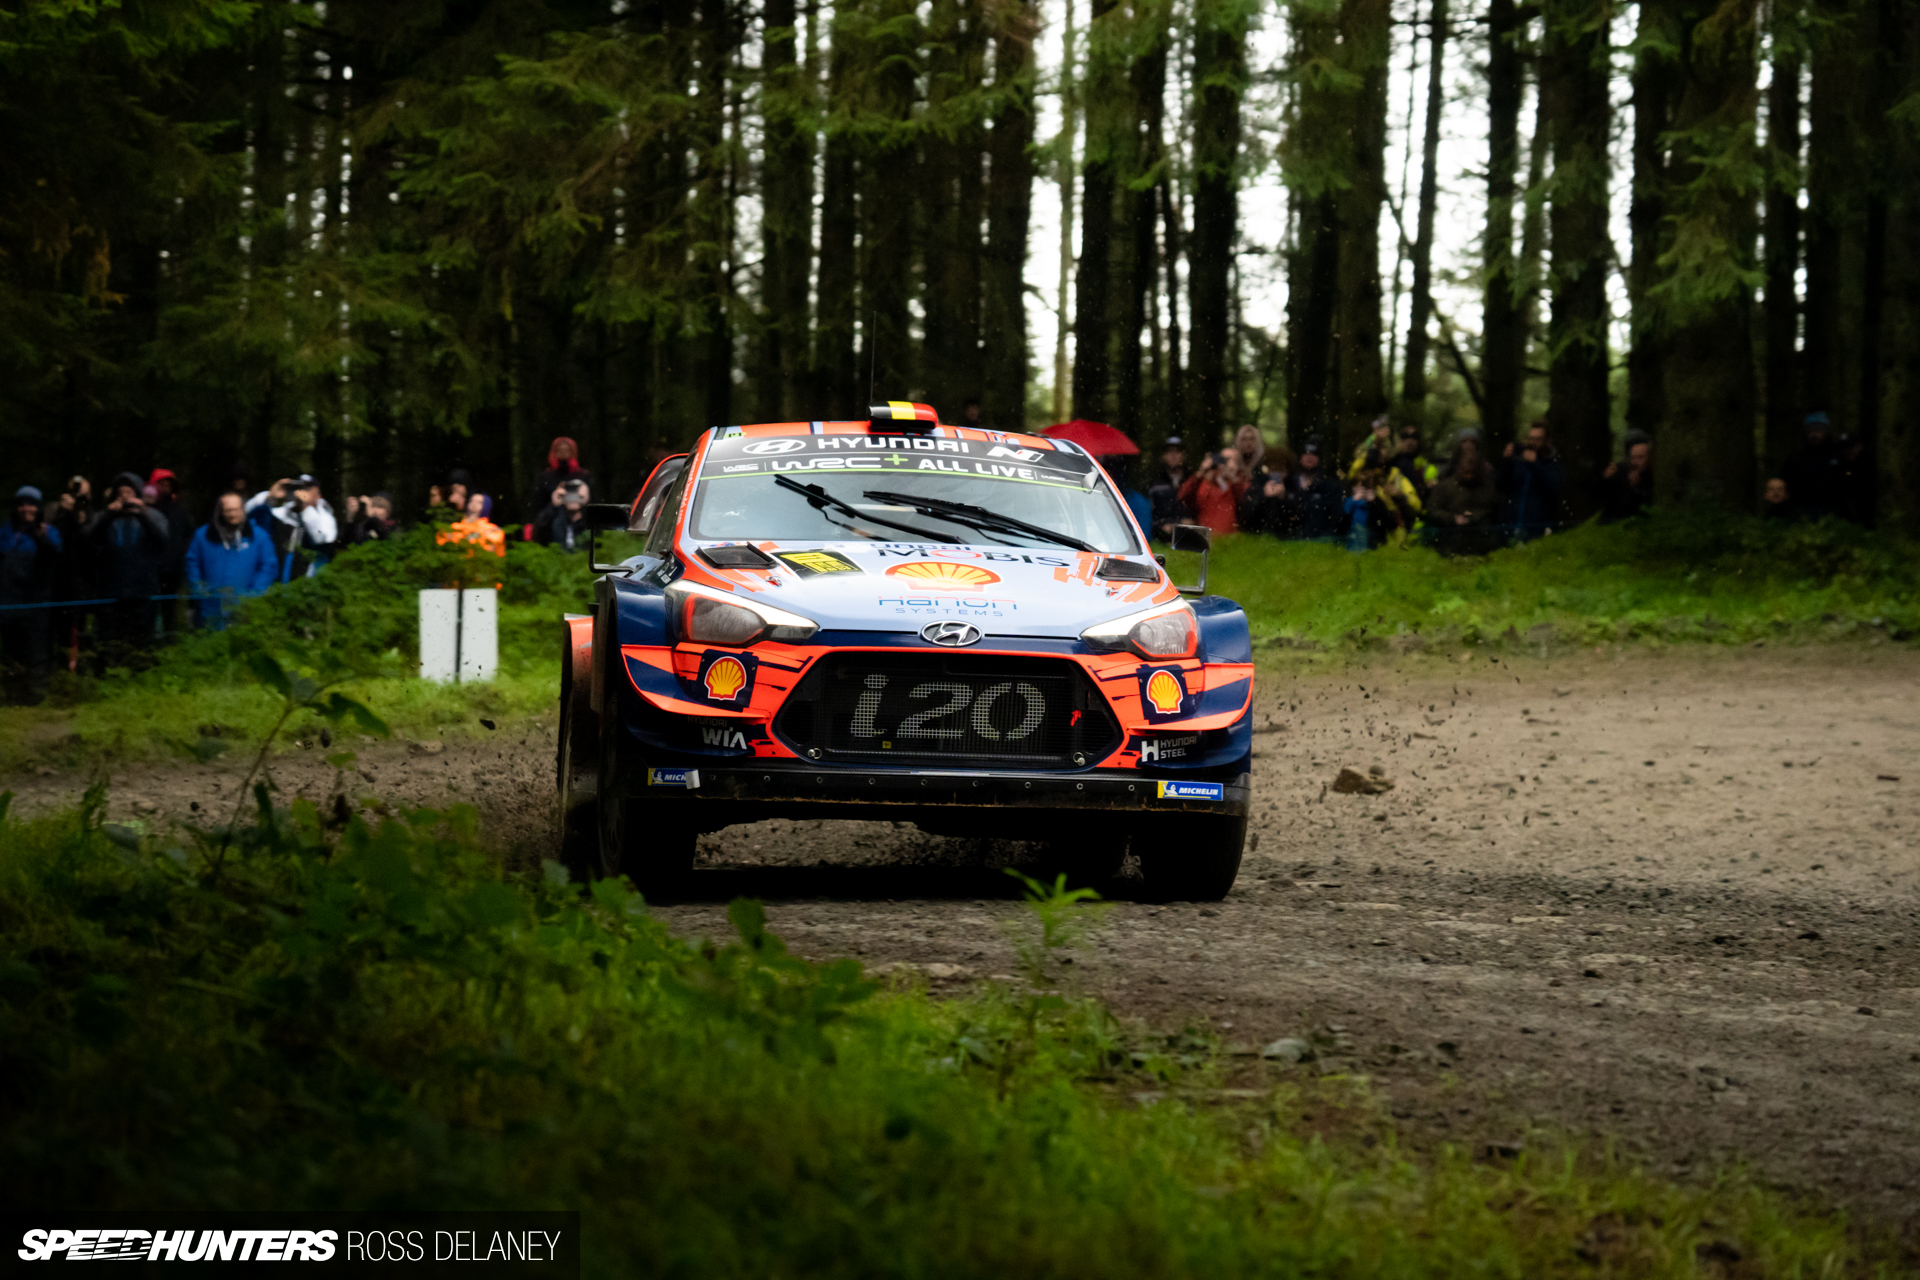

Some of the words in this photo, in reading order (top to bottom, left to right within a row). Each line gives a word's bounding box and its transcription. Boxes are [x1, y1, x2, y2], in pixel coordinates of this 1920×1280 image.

[818, 437, 969, 453] HYUNDAI
[918, 458, 969, 473] ALL
[975, 463, 1034, 480] LIVE
[877, 548, 1071, 567] MOBIS
[895, 608, 1004, 617] SYSTEMS
[849, 673, 1046, 742] i20
[1160, 736, 1197, 749] HYUNDAI
[1160, 748, 1187, 759] STEEL
[1179, 787, 1219, 795] MICHELIN
